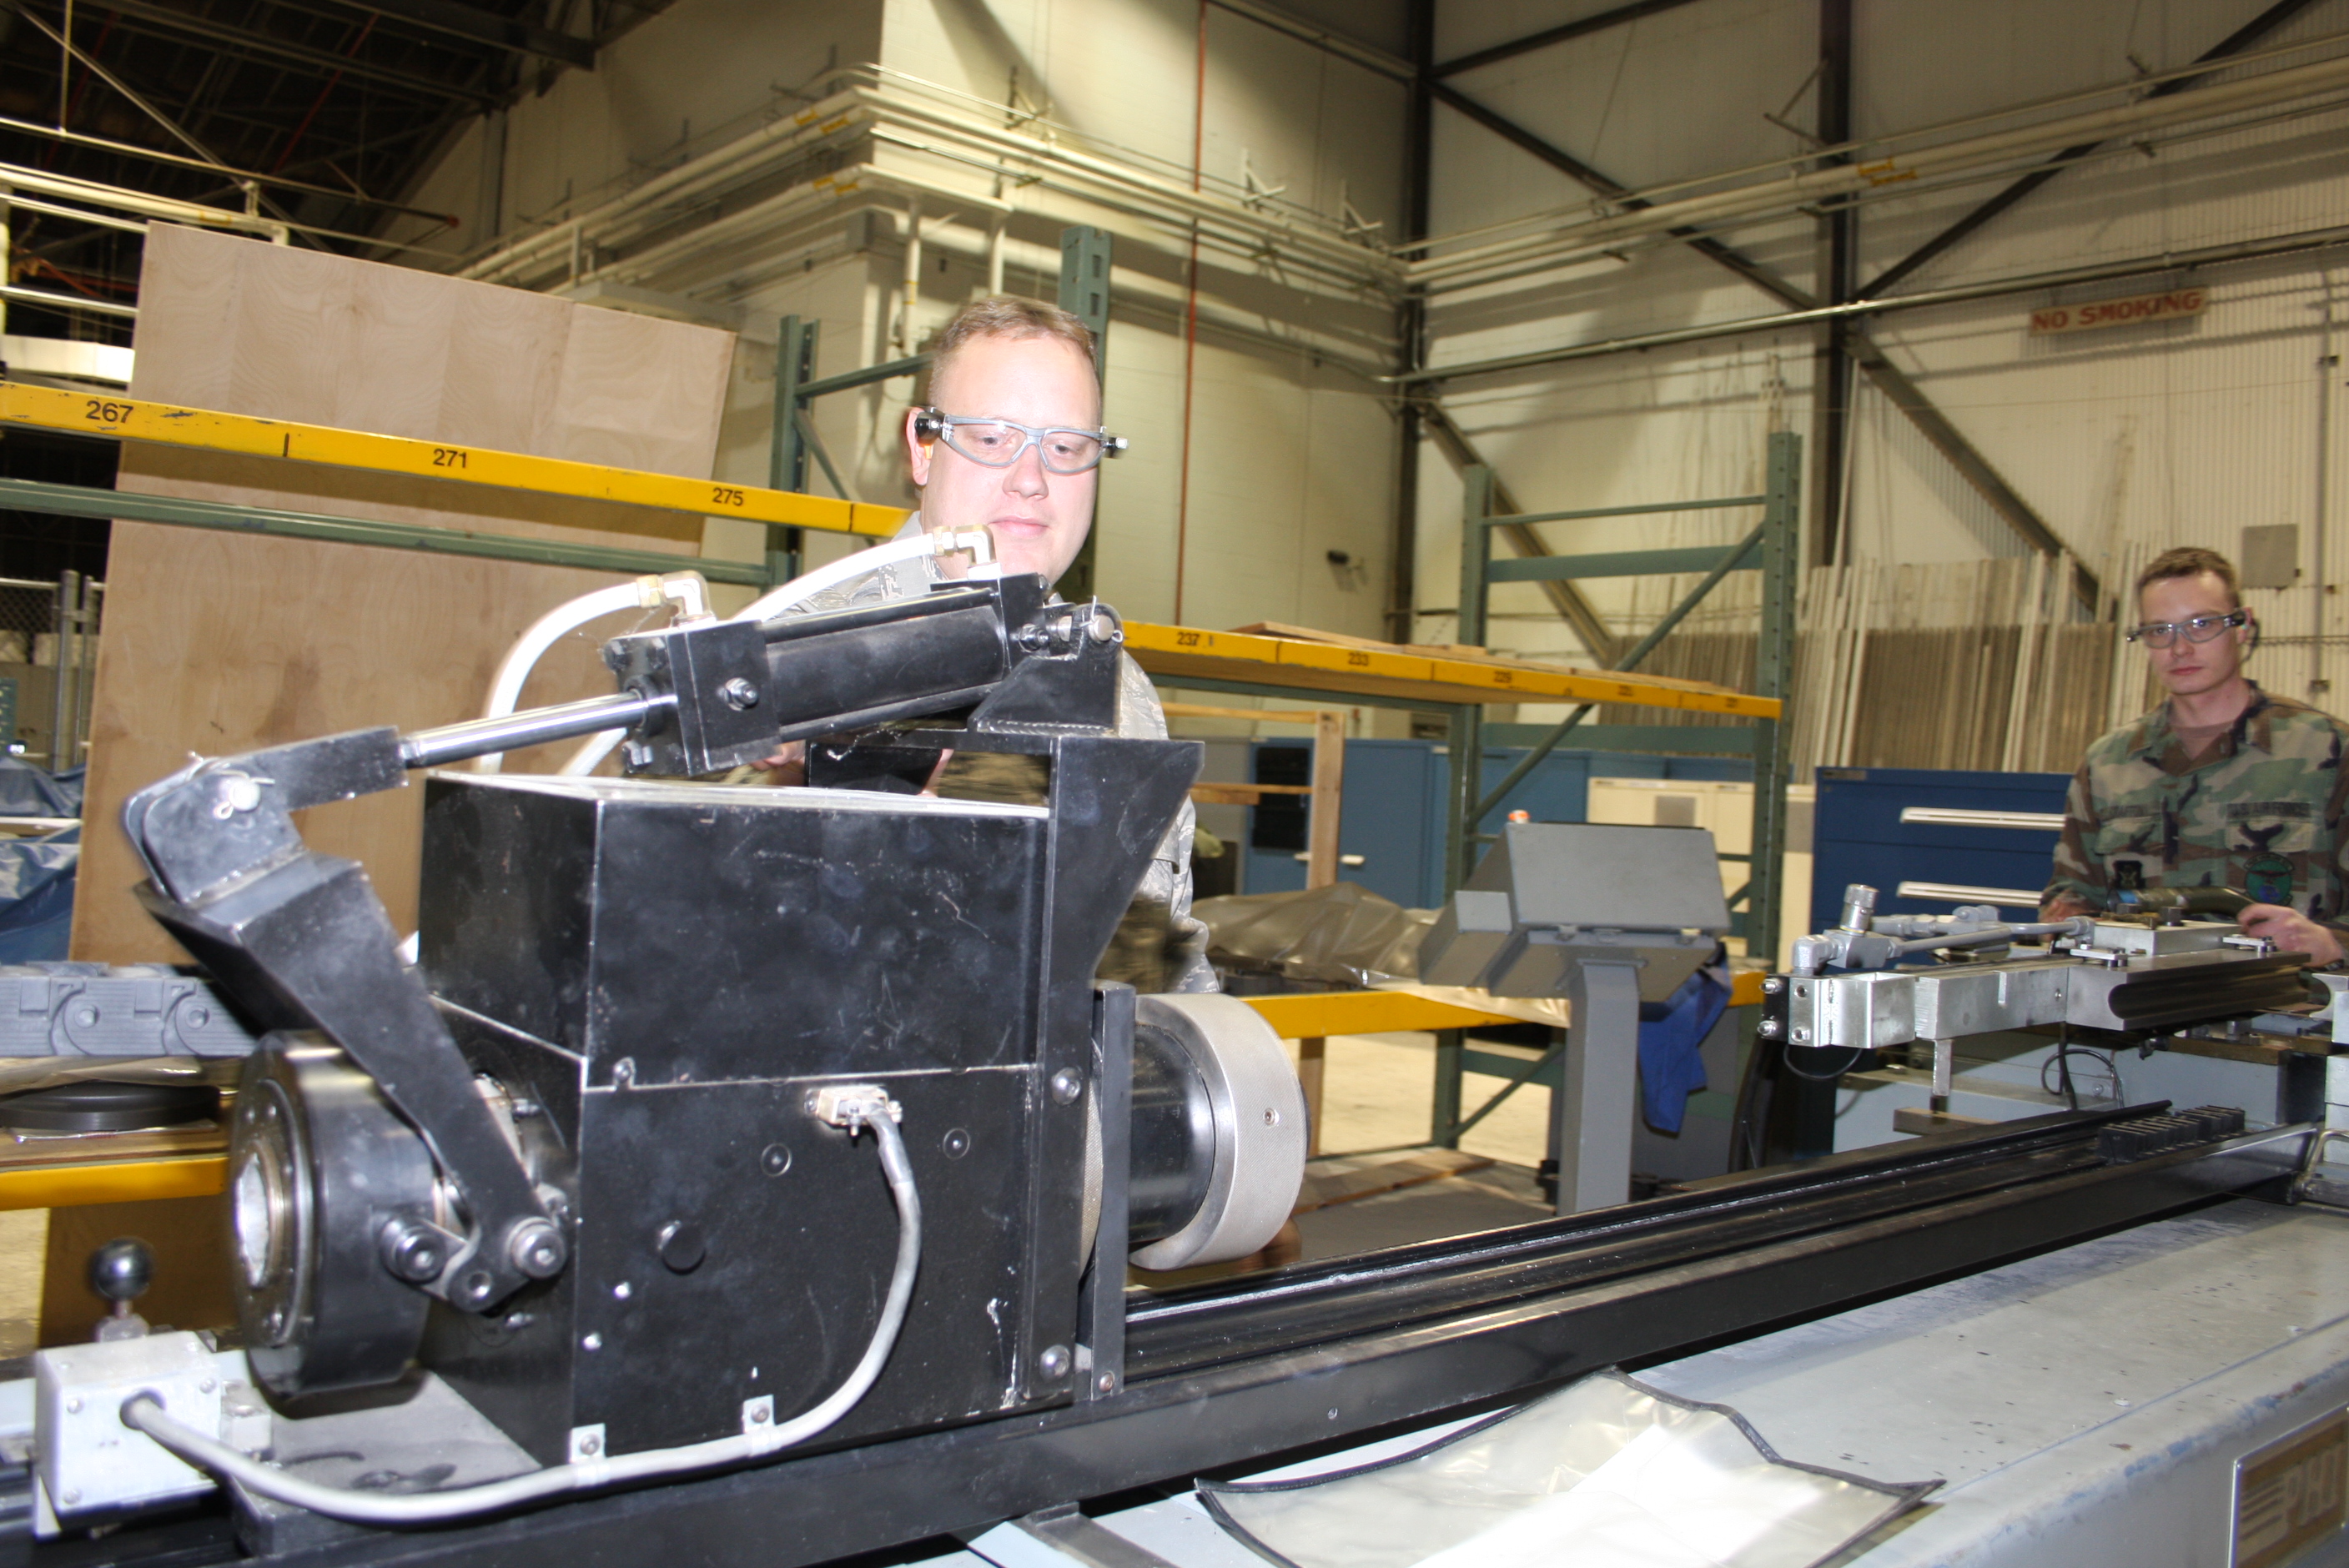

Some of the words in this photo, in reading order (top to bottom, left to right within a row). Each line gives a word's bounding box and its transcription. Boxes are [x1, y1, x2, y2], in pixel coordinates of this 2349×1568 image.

[2031, 310, 2068, 331] NO
[2079, 292, 2202, 325] SMOKING
[85, 400, 134, 424] 267
[432, 448, 467, 469] 271
[712, 487, 744, 506] 275
[1177, 631, 1200, 646] 237
